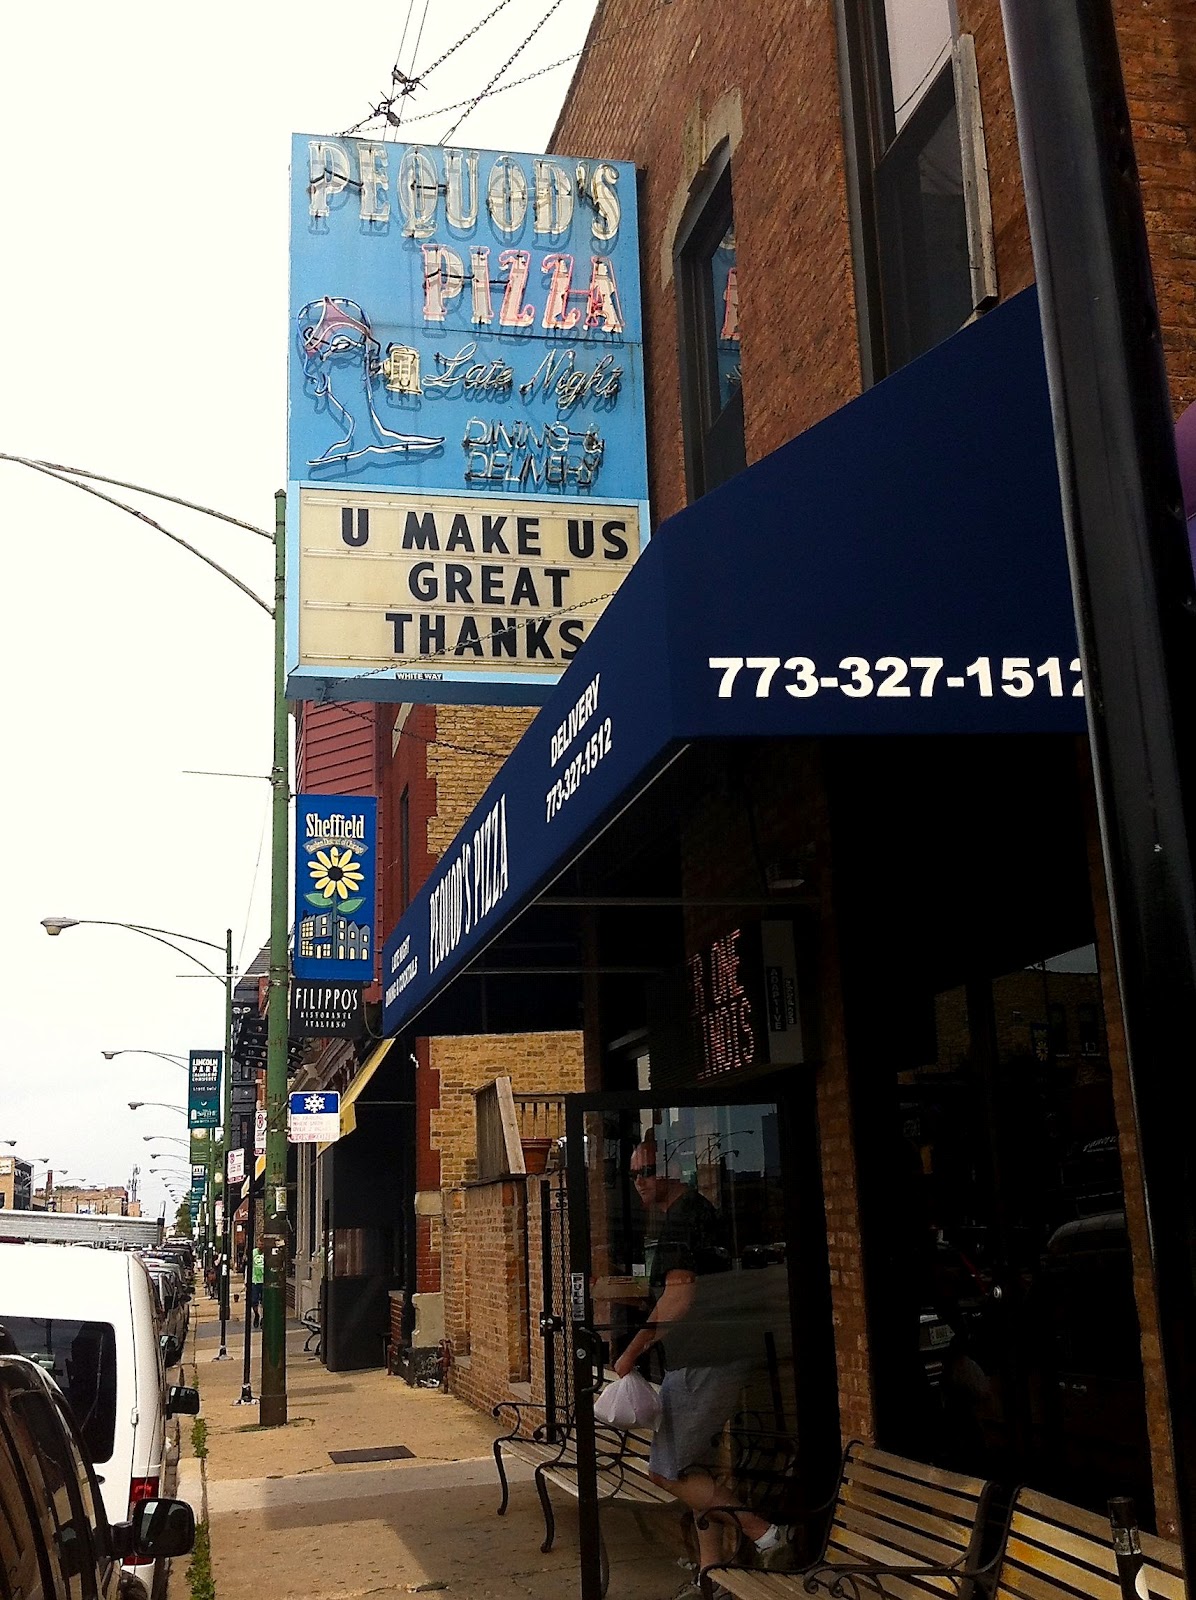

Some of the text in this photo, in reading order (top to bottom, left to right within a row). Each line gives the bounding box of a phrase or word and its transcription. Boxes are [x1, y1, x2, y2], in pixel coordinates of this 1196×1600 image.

[308, 141, 621, 240] PEQUOD'S
[421, 243, 626, 333] PIZZA
[422, 343, 623, 410] Late Night
[462, 416, 570, 452] DINING
[465, 450, 601, 485] DELIVERY
[341, 508, 629, 560] U MAKE US
[408, 562, 570, 608] GREAT
[386, 613, 585, 660] THANKS
[397, 672, 443, 681] WHITE WAY
[550, 673, 600, 767] DELIVERY
[546, 717, 613, 822] 773-327-1512
[306, 813, 364, 839] Sheffield
[430, 794, 508, 974] PEQUOD'S PIZZA
[295, 987, 358, 1011] FILIPPO'S
[300, 1011, 352, 1020] RISTORANTE
[771, 968, 782, 1030] ADAPTIVE
[305, 1020, 346, 1028] ITALIANO
[192, 1058, 218, 1066] LINCOLN
